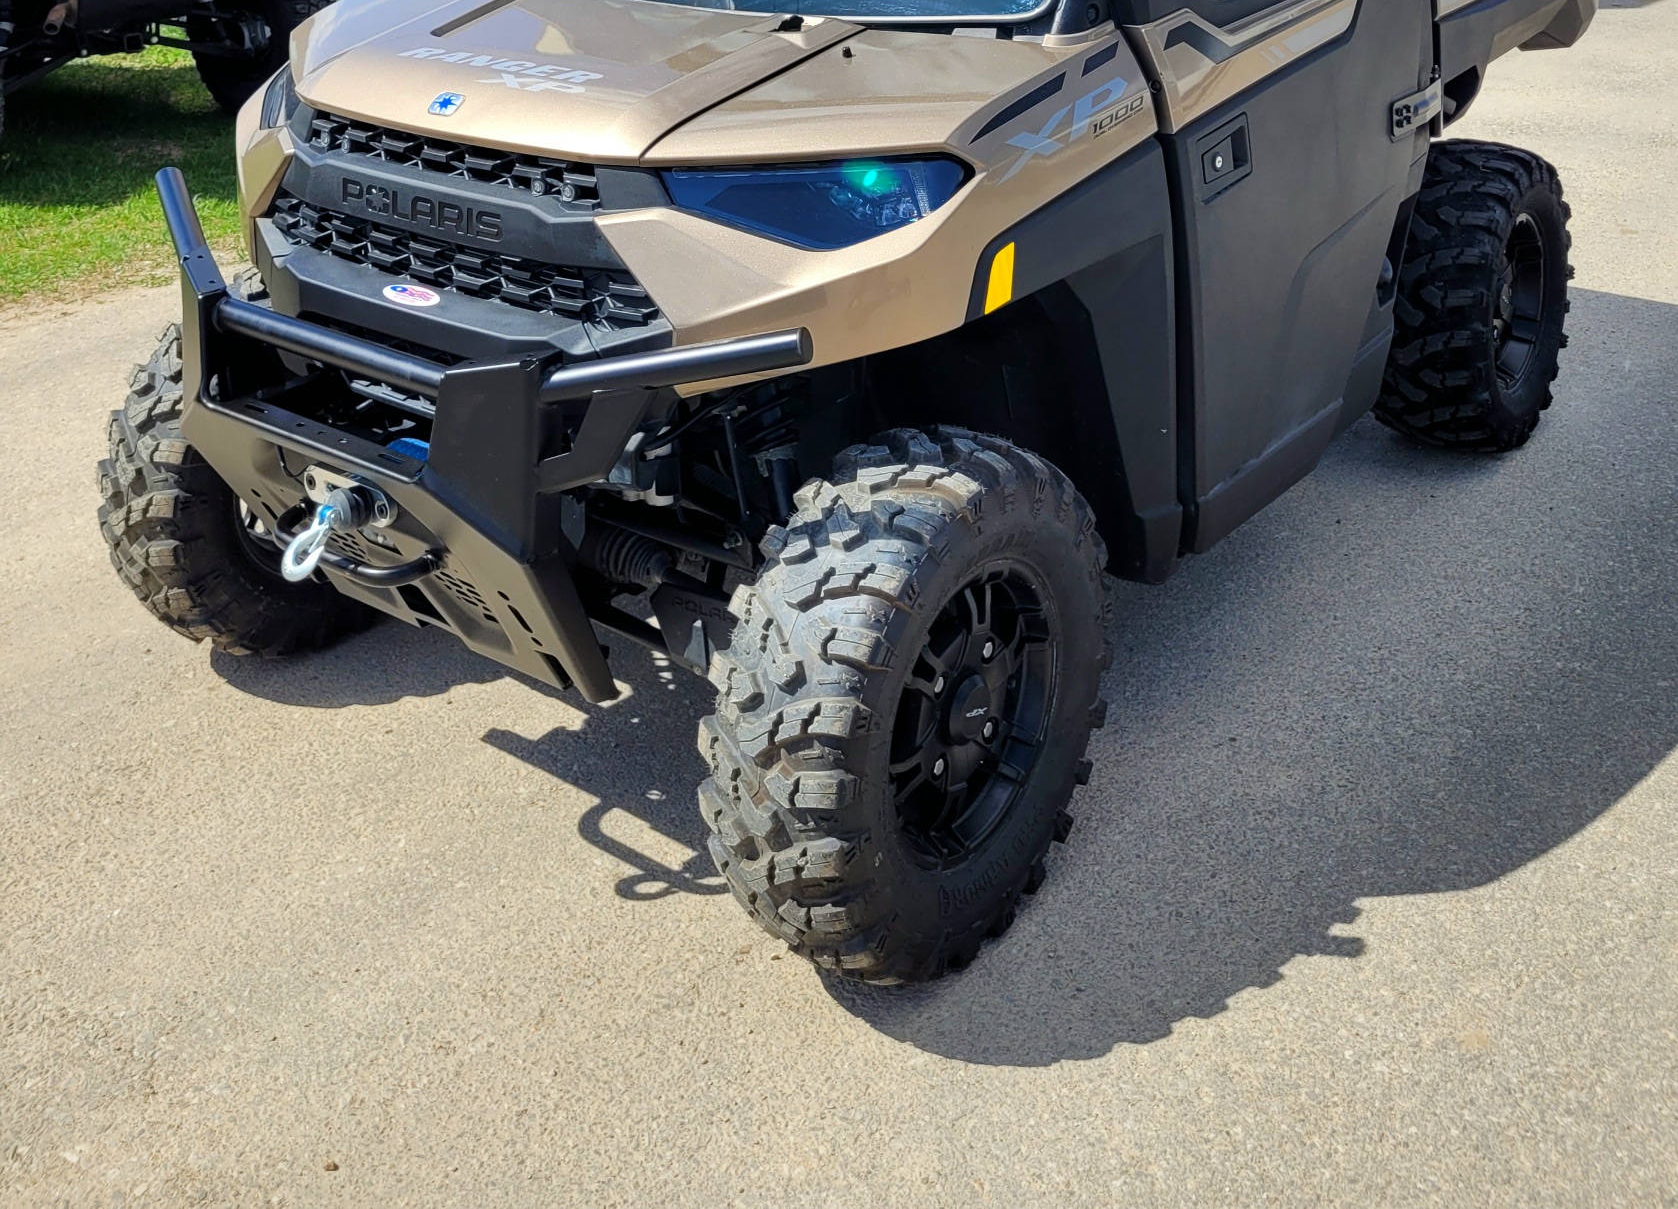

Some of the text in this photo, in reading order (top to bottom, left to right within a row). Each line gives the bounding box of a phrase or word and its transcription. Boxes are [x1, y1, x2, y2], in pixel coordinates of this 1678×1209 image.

[397, 47, 604, 83] RANGER
[475, 73, 586, 93] XP
[995, 76, 1128, 186] XP
[1093, 95, 1144, 135] 1000
[342, 177, 503, 243] POLARIS
